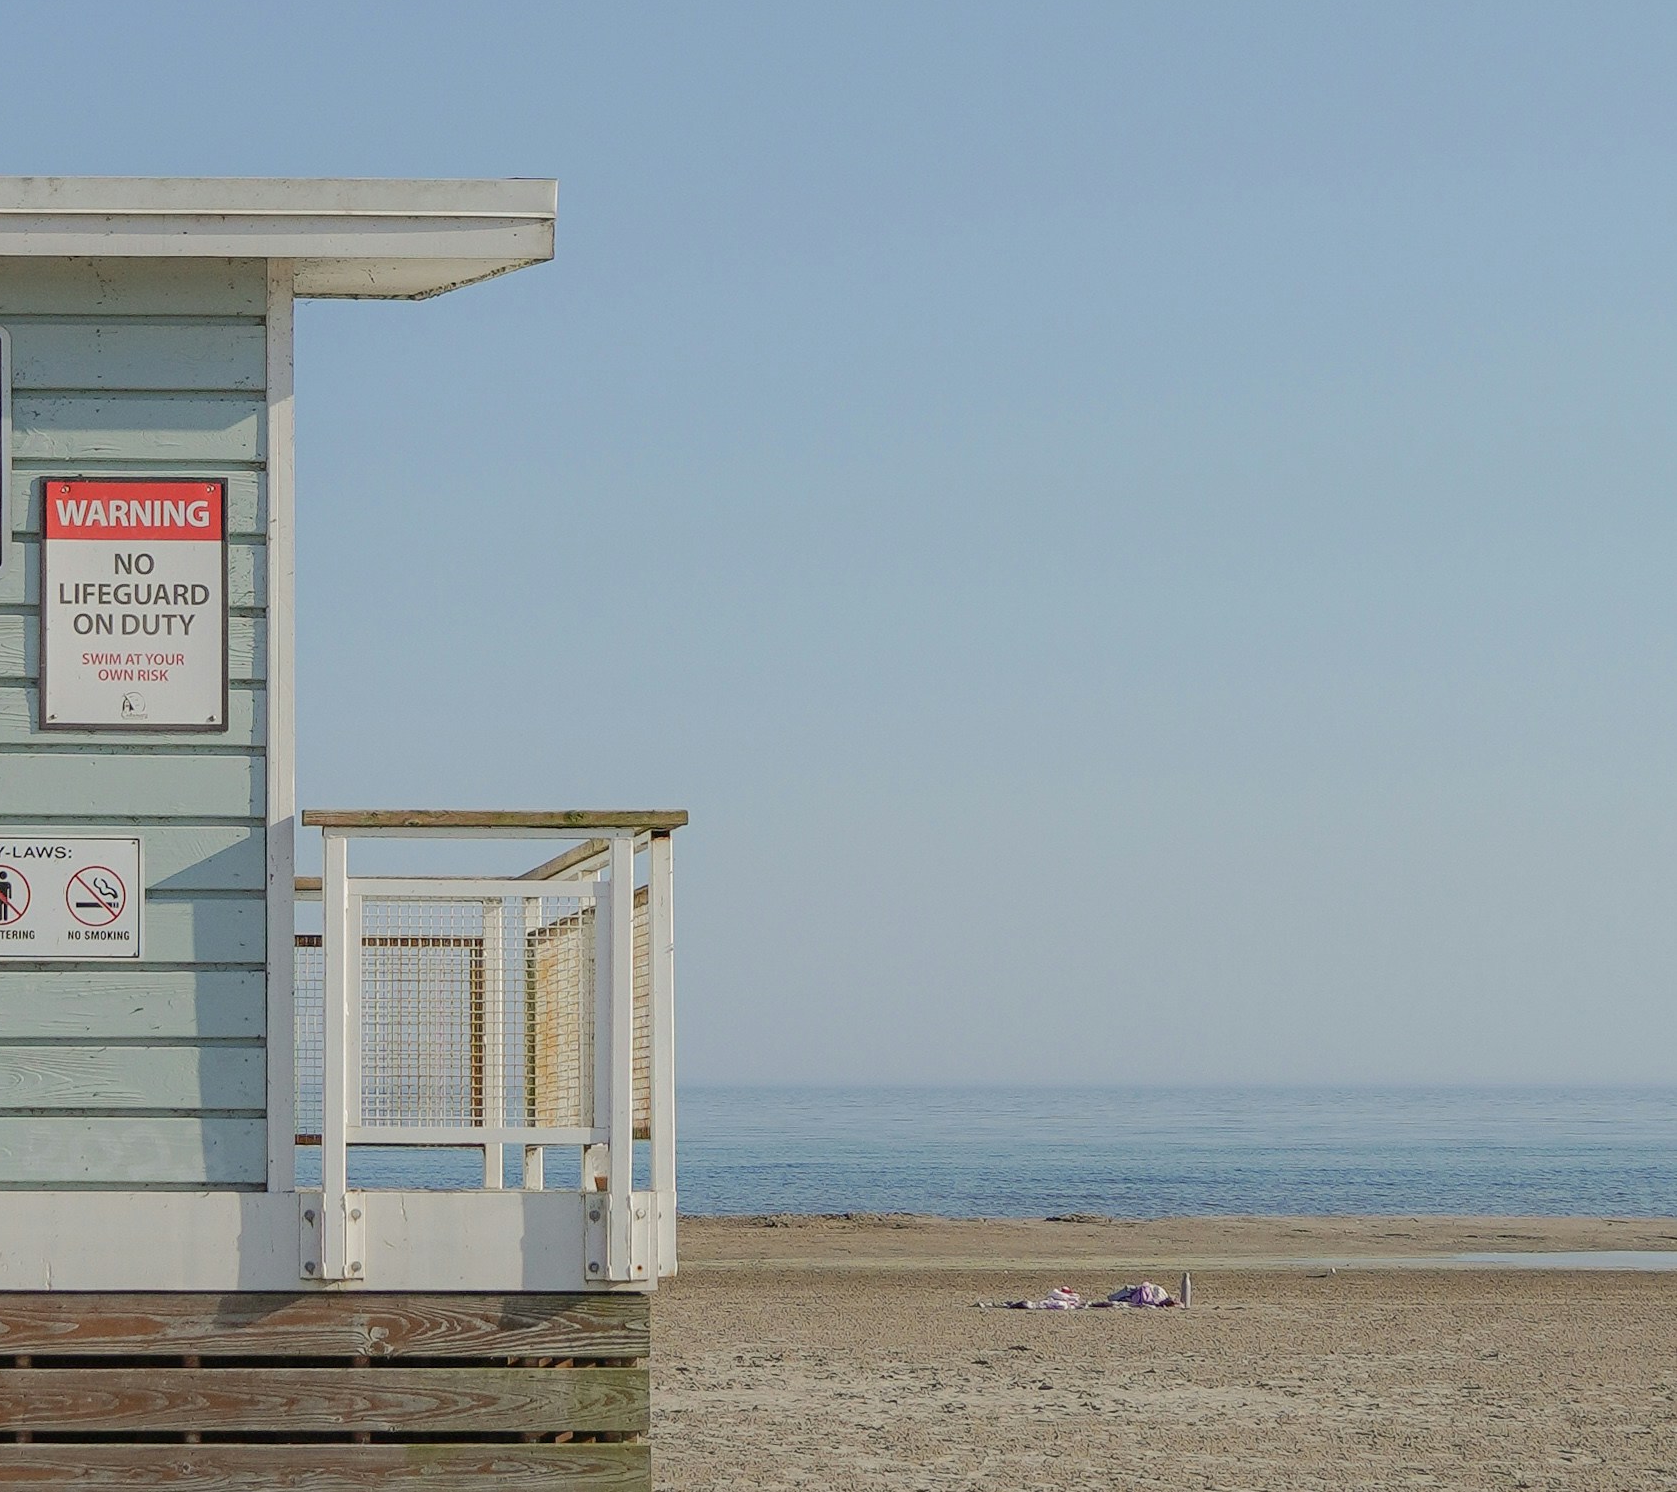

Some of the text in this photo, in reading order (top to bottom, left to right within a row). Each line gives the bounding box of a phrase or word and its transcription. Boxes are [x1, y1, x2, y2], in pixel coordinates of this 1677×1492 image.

[55, 499, 211, 528] WARNING
[114, 553, 155, 575] NO
[59, 583, 210, 605] LIFEGUARD
[73, 613, 196, 636] ON DUTY
[82, 653, 185, 666] SWIM AT YOUR
[98, 669, 168, 681] OWN RISK
[68, 931, 130, 940] NO SMOKING
